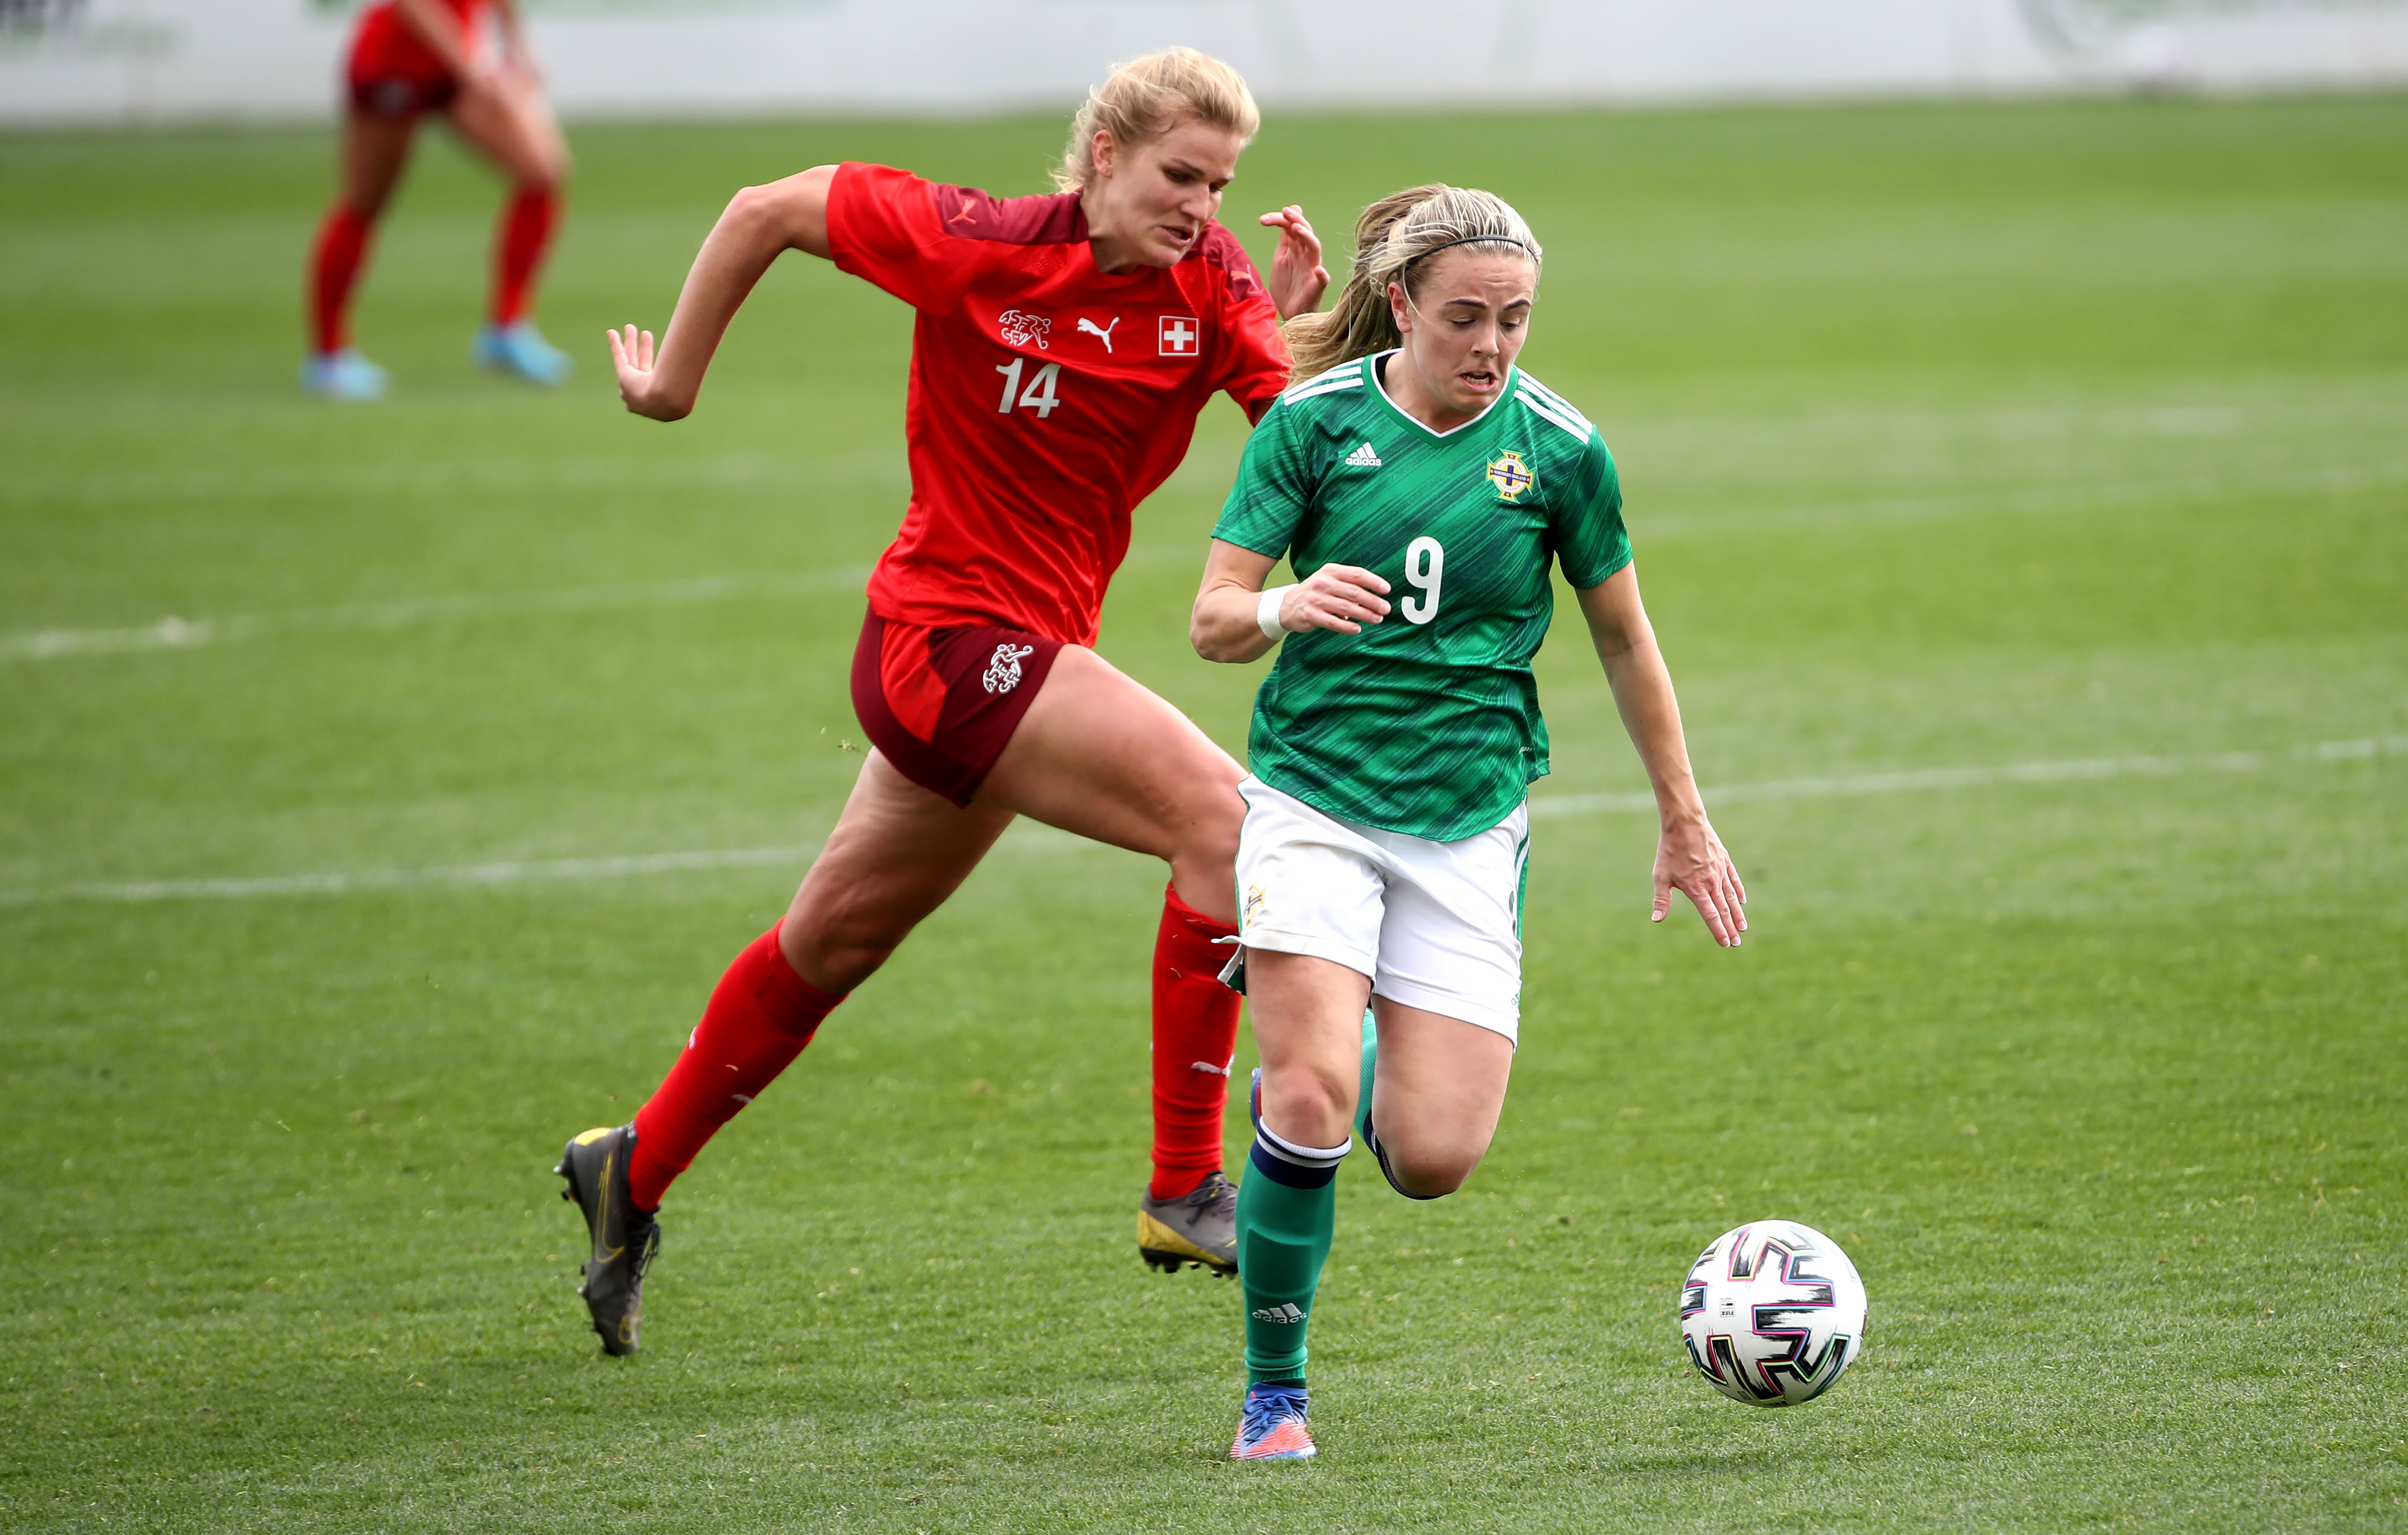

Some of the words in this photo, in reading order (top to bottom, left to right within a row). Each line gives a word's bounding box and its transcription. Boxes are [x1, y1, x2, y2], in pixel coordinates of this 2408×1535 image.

[996, 357, 1062, 419] 14
[1345, 457, 1382, 467] adidas
[1401, 536, 1444, 625] 9
[1252, 1311, 1307, 1324] adidas
